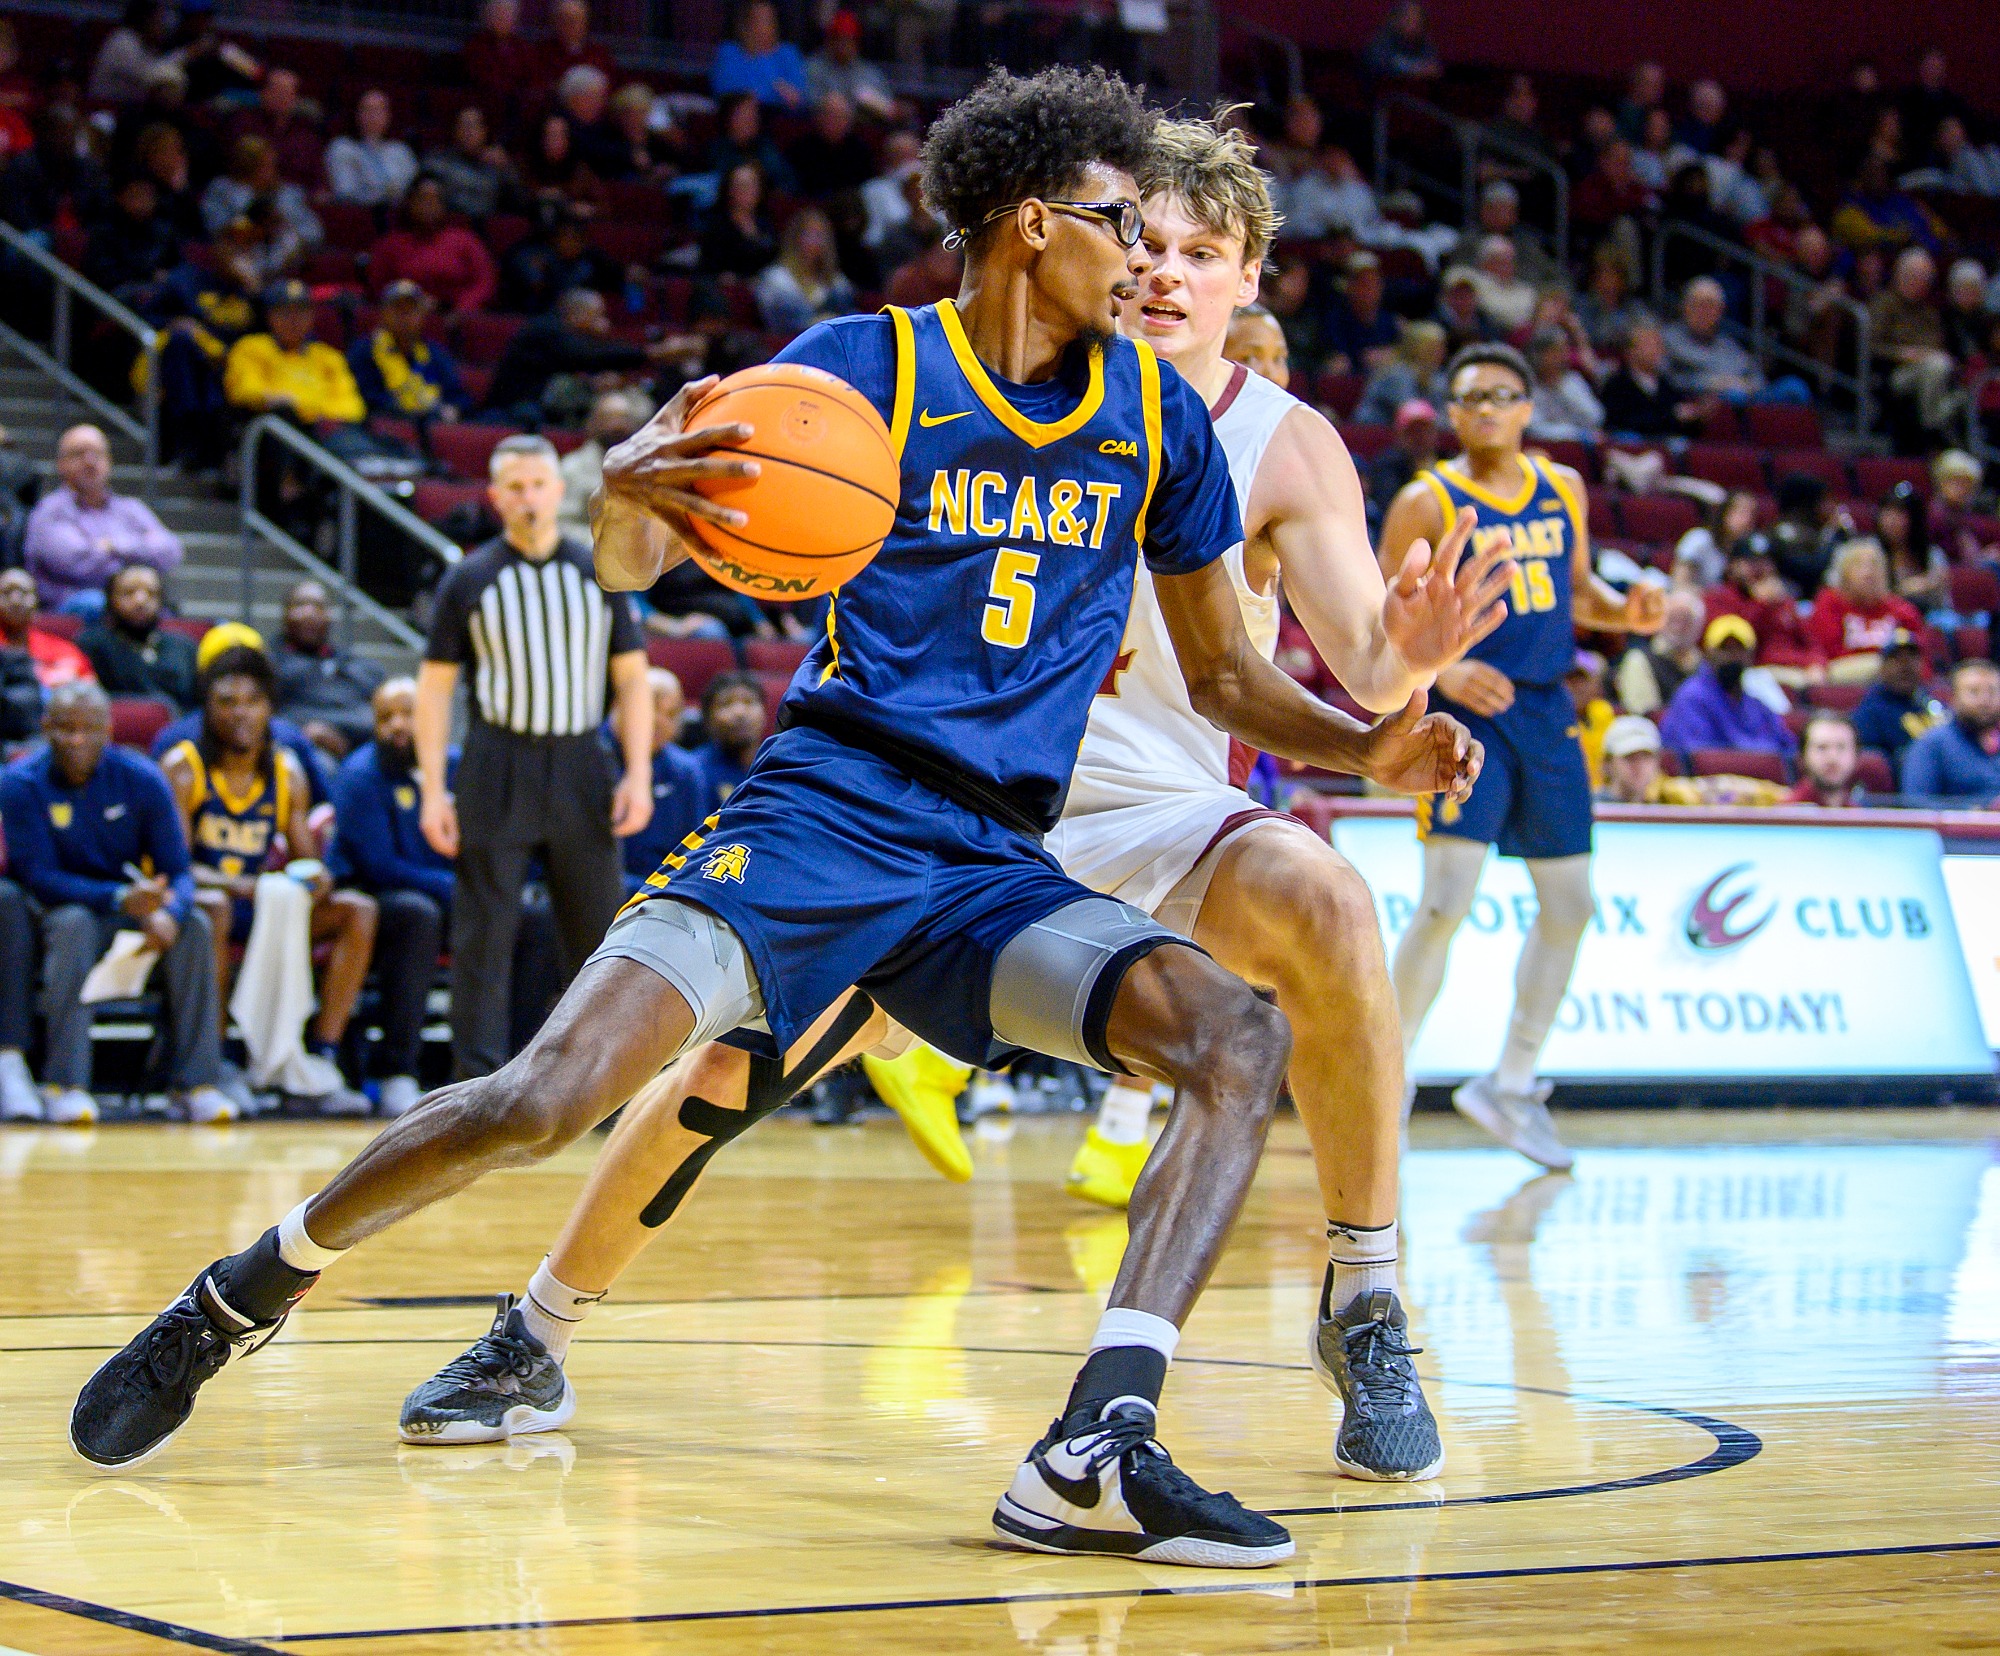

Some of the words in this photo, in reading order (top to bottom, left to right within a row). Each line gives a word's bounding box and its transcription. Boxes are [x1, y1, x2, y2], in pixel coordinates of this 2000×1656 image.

[1098, 440, 1138, 457] CAA
[927, 468, 1122, 550] NCA&T
[980, 546, 1041, 649] 5
[1510, 559, 1557, 615] 15
[1384, 894, 1645, 935] POEIX
[1796, 897, 1931, 940] CLUB
[1554, 991, 1649, 1033] OIN
[1662, 991, 1848, 1033] TODAY!
